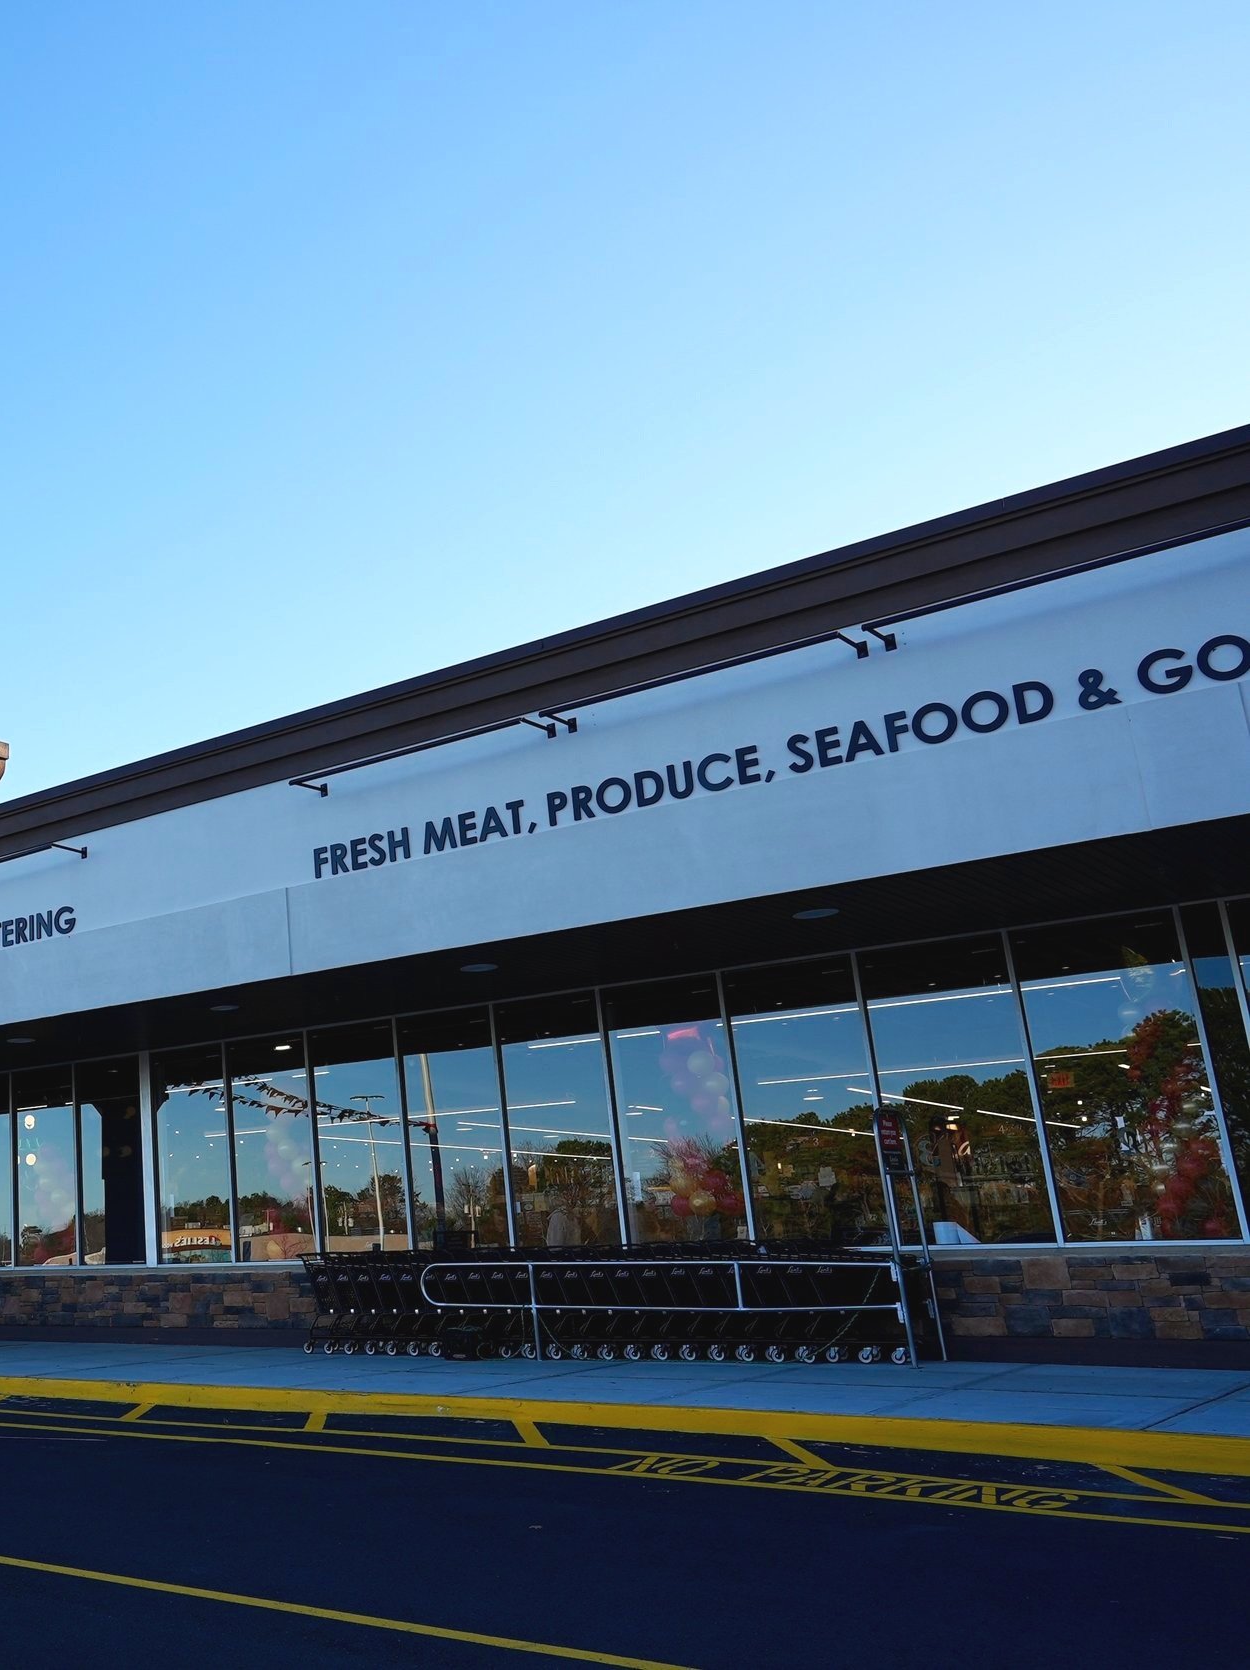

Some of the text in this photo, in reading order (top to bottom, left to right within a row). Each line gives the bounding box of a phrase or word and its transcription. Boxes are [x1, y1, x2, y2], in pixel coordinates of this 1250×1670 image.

[313, 826, 411, 880] FRESH
[423, 798, 537, 855] MEAT,
[546, 744, 775, 827] PRODUCE,
[787, 680, 1054, 774] SEAFOOD
[1078, 668, 1122, 711] &
[611, 1455, 1080, 1509] NO PARKING
